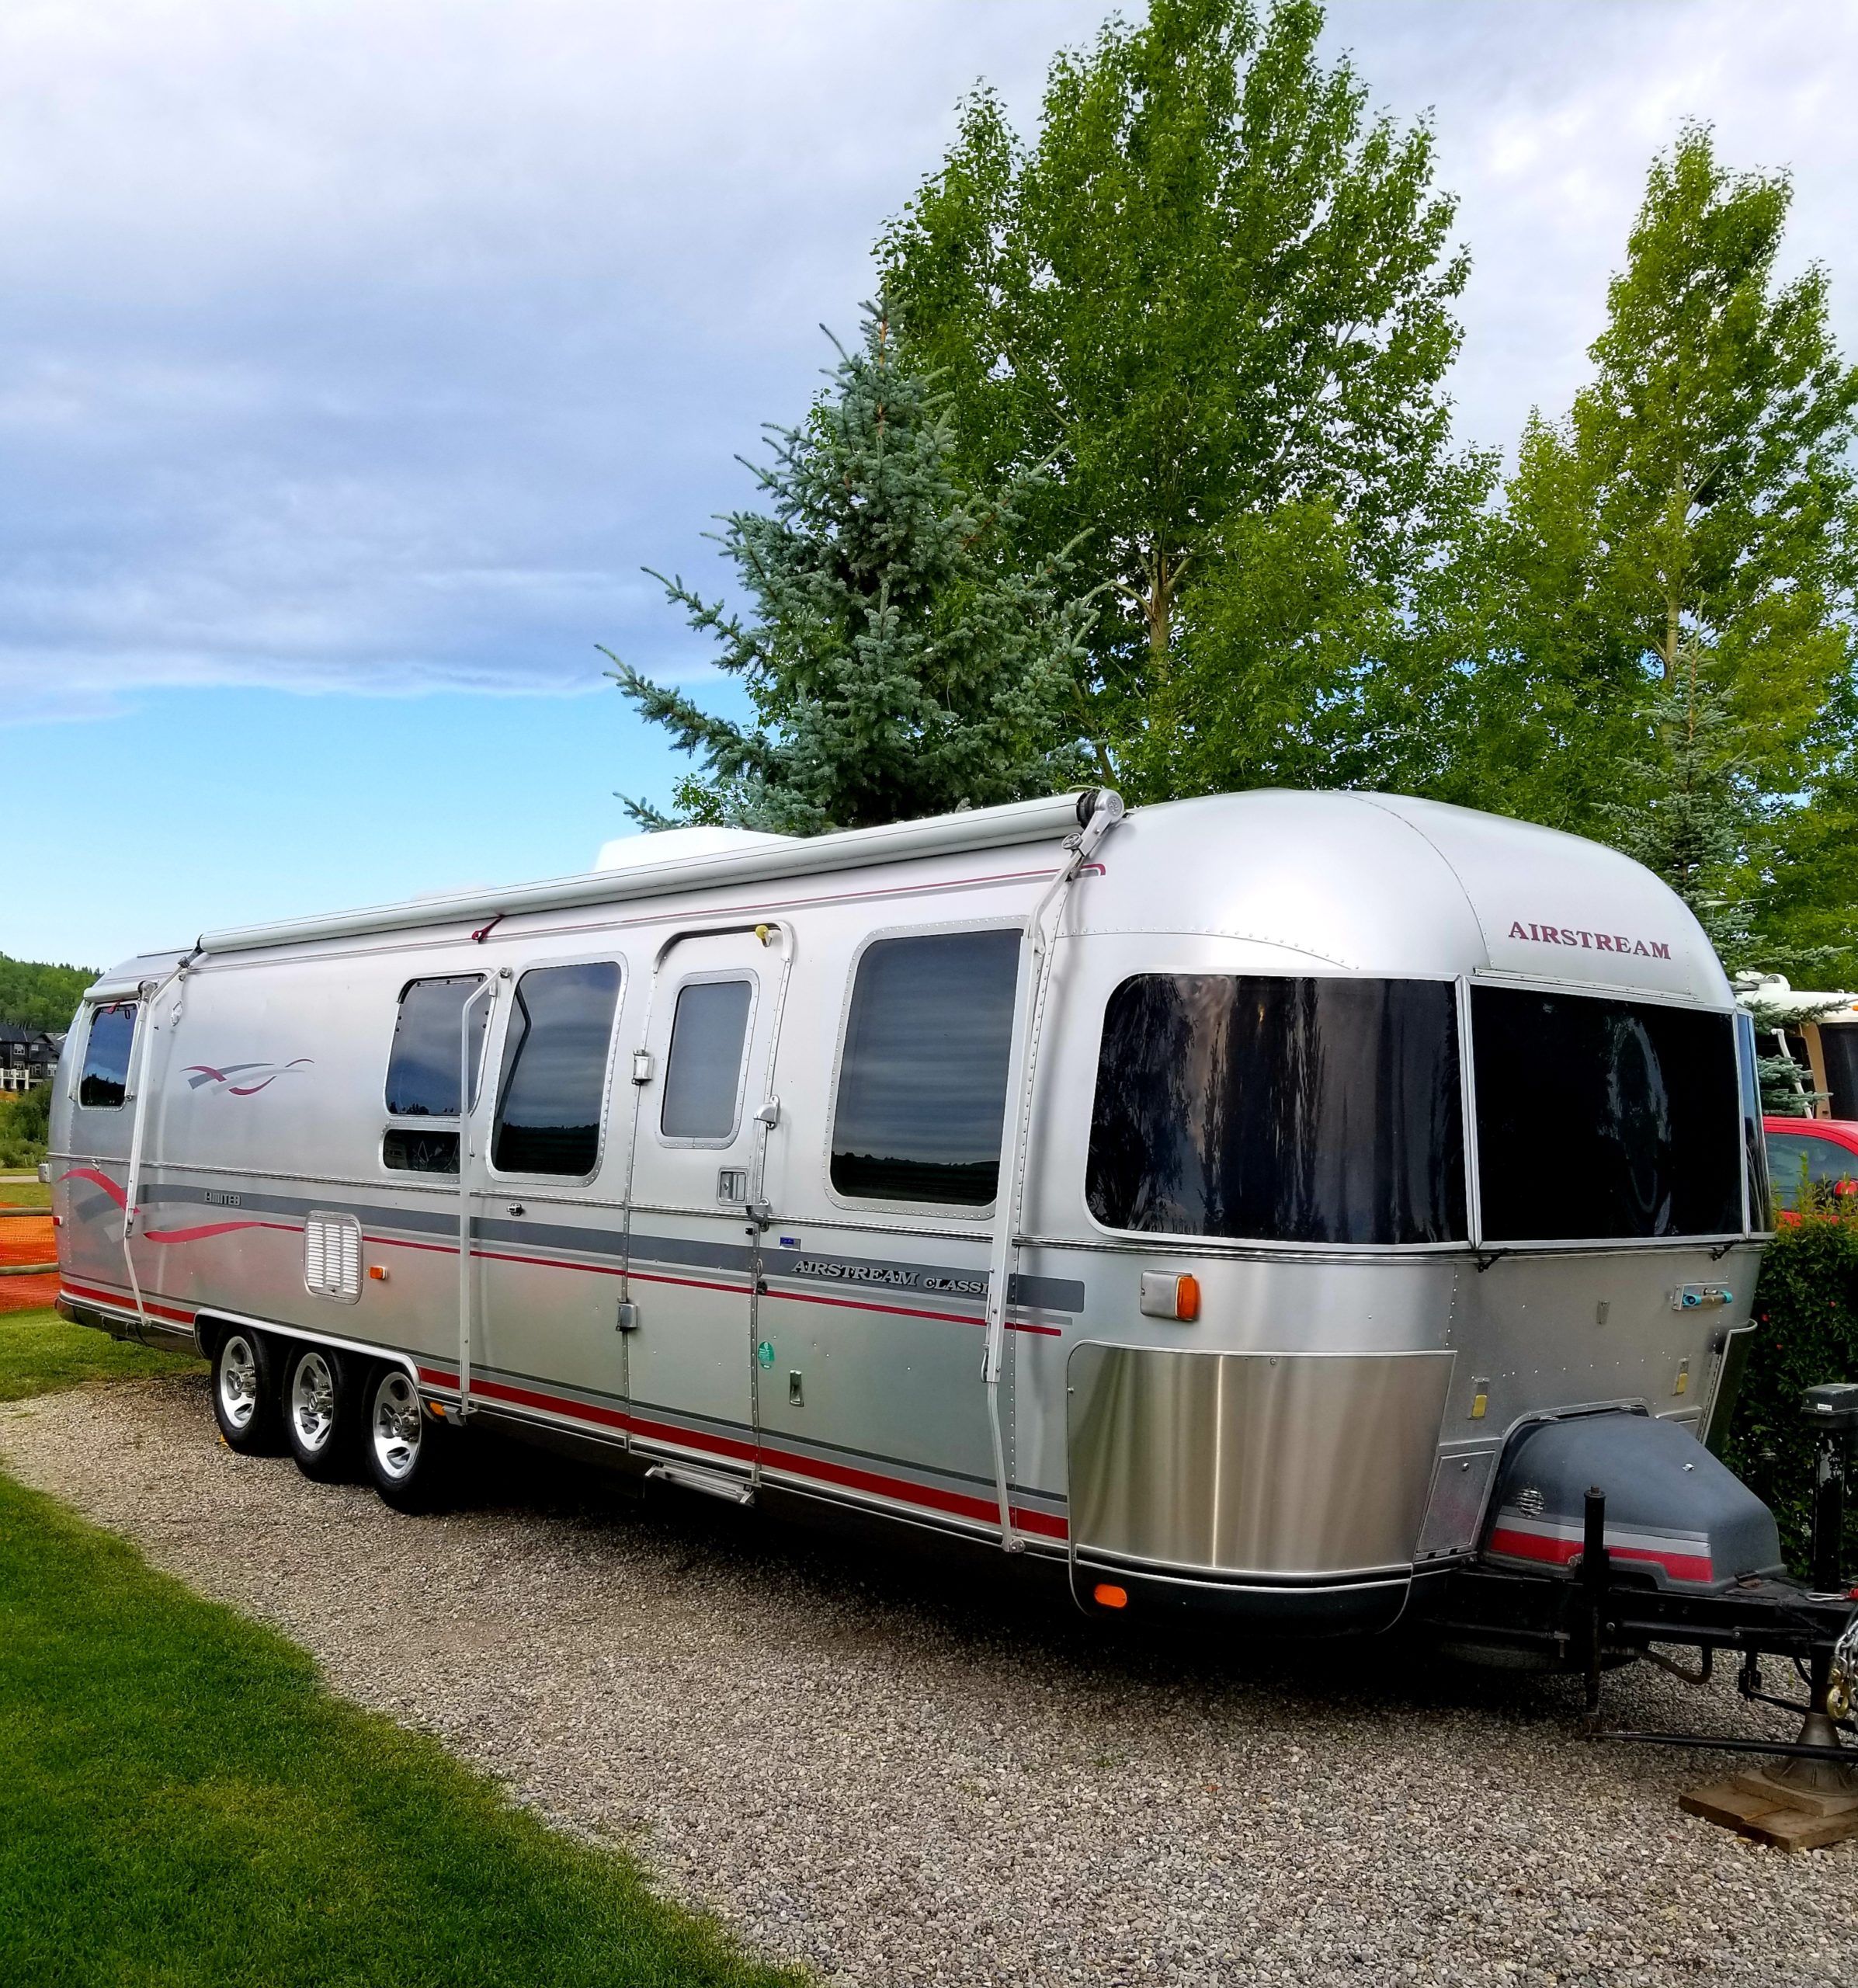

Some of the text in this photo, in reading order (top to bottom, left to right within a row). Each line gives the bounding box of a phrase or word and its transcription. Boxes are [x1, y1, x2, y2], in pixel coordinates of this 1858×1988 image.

[1509, 921, 1672, 960] AIRSTREAM
[204, 1191, 241, 1206] LIMITED
[791, 1260, 989, 1295] AIRSTREAM CLASSI
